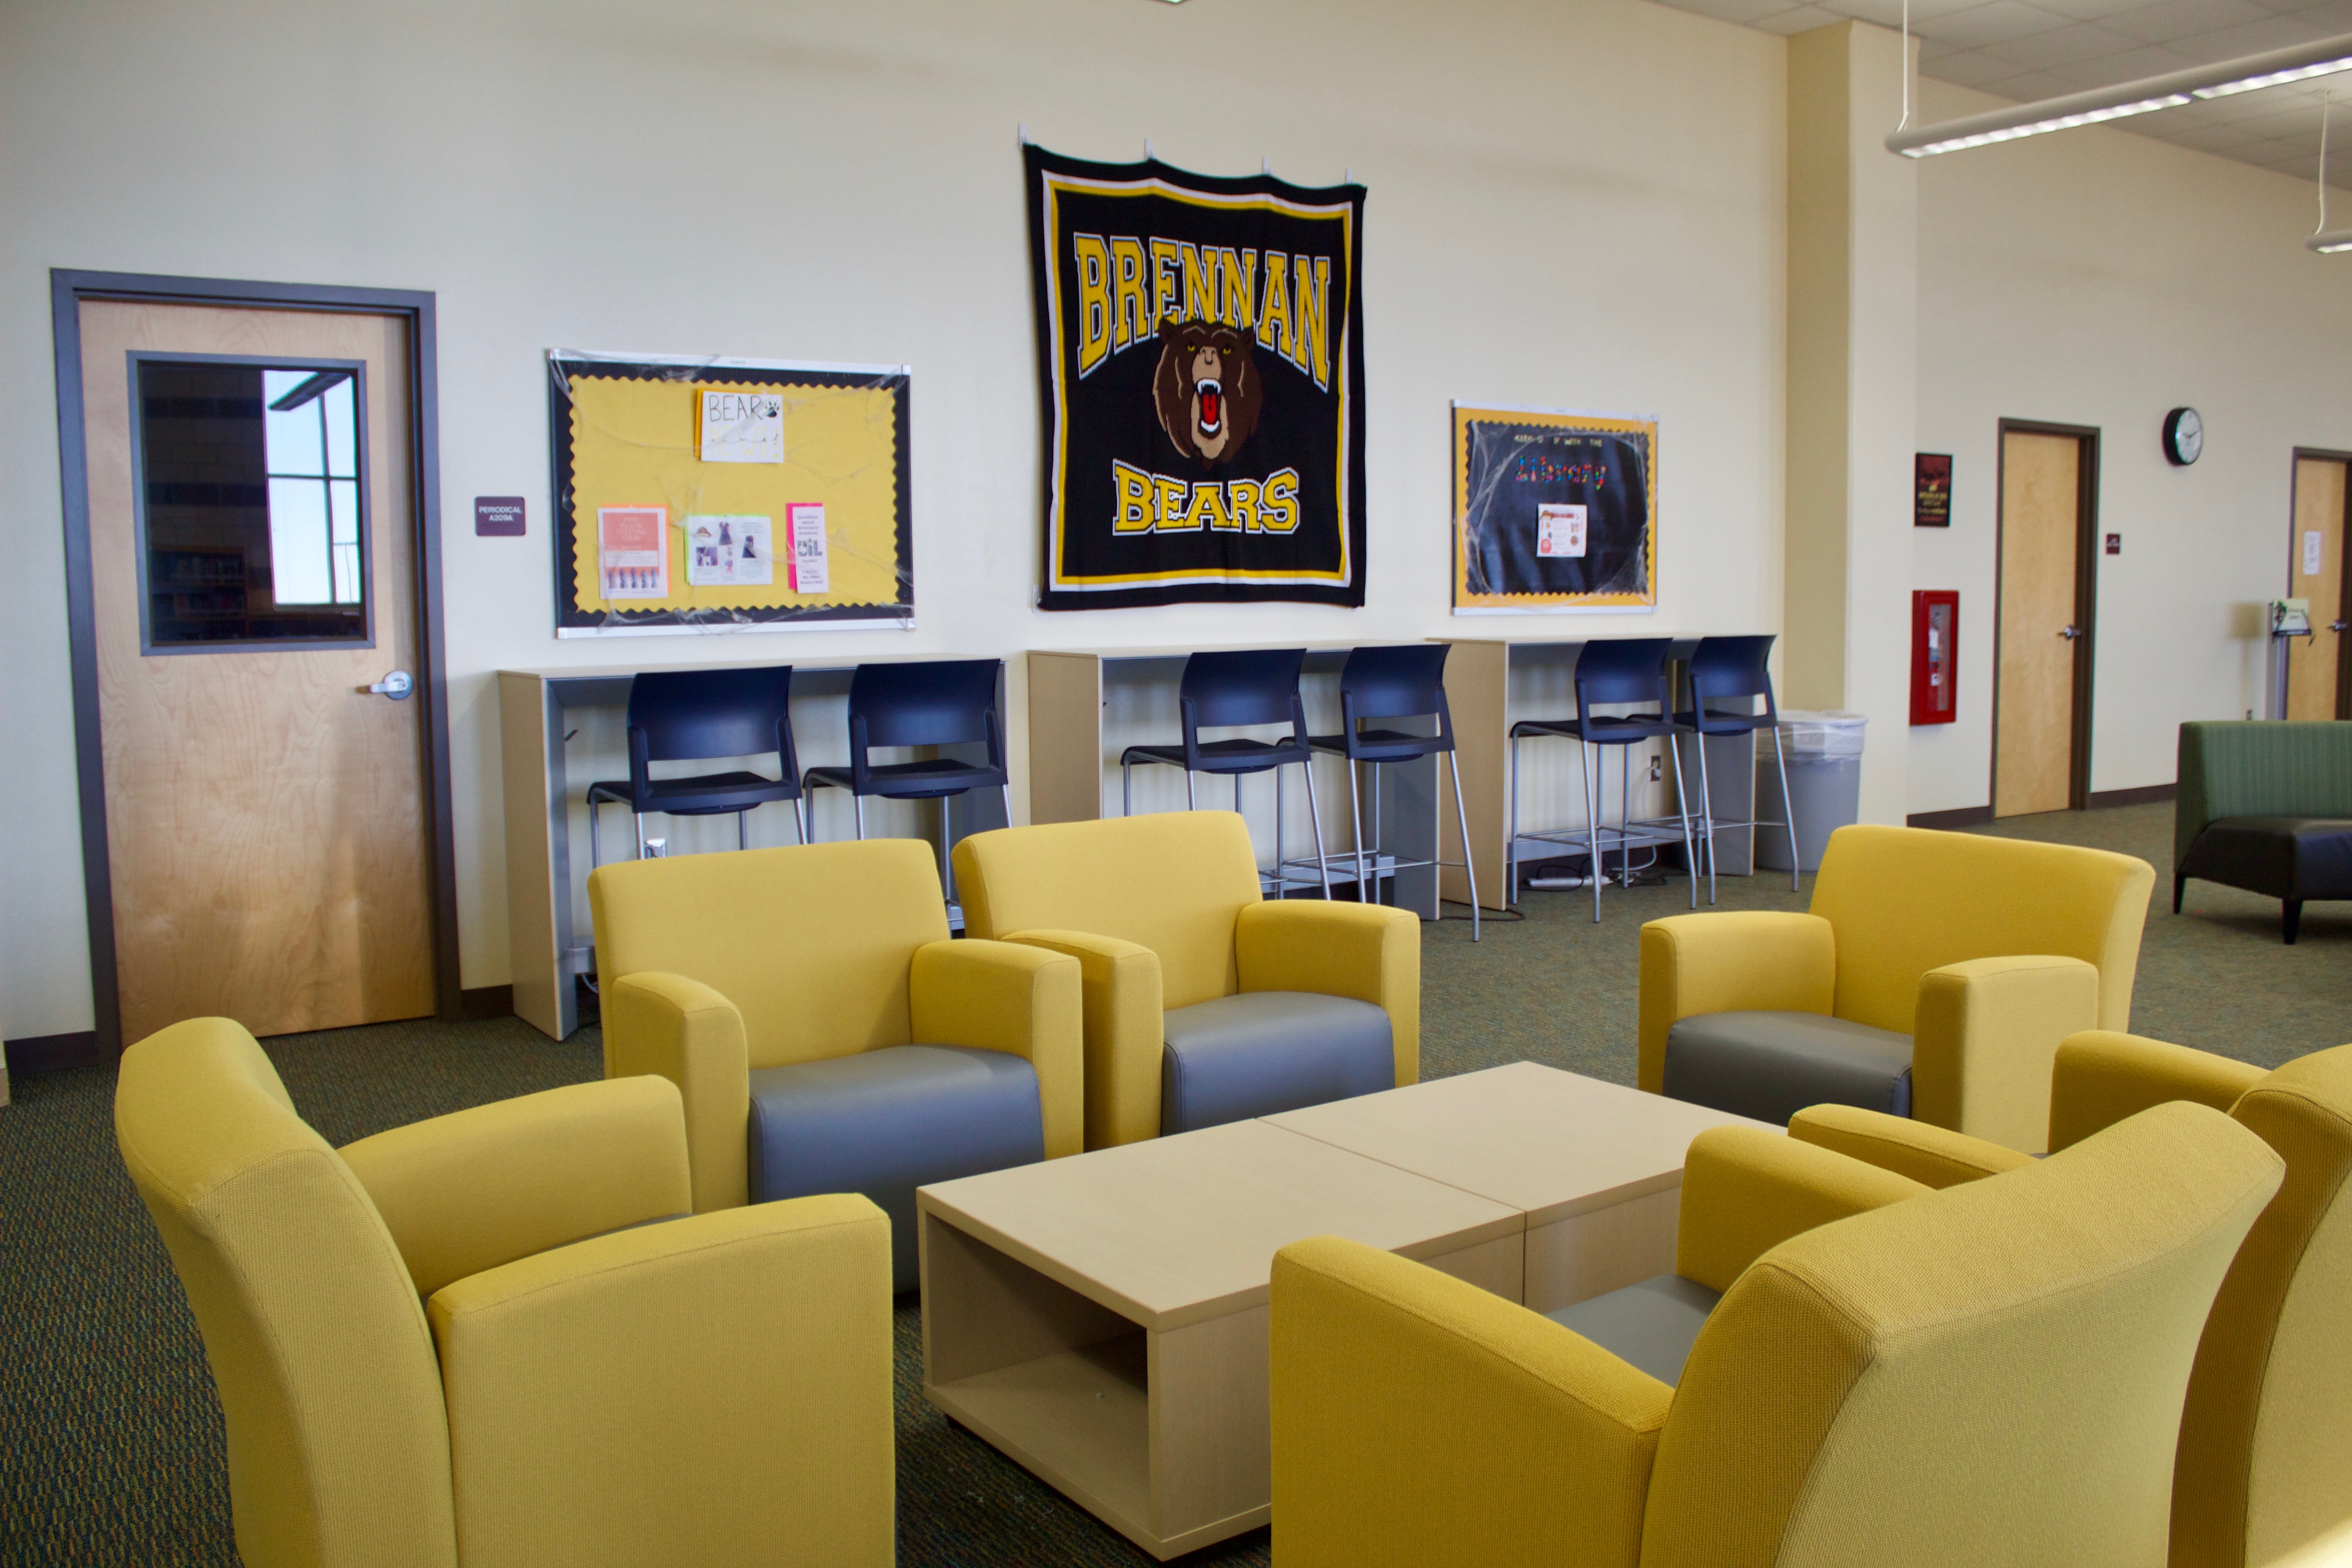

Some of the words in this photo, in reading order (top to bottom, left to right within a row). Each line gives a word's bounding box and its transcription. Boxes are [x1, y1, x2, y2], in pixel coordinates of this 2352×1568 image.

[1073, 232, 1331, 394] BRENNAN
[709, 395, 763, 422] BEAR
[1112, 458, 1300, 536] BEARS
[1515, 455, 1607, 491] Library
